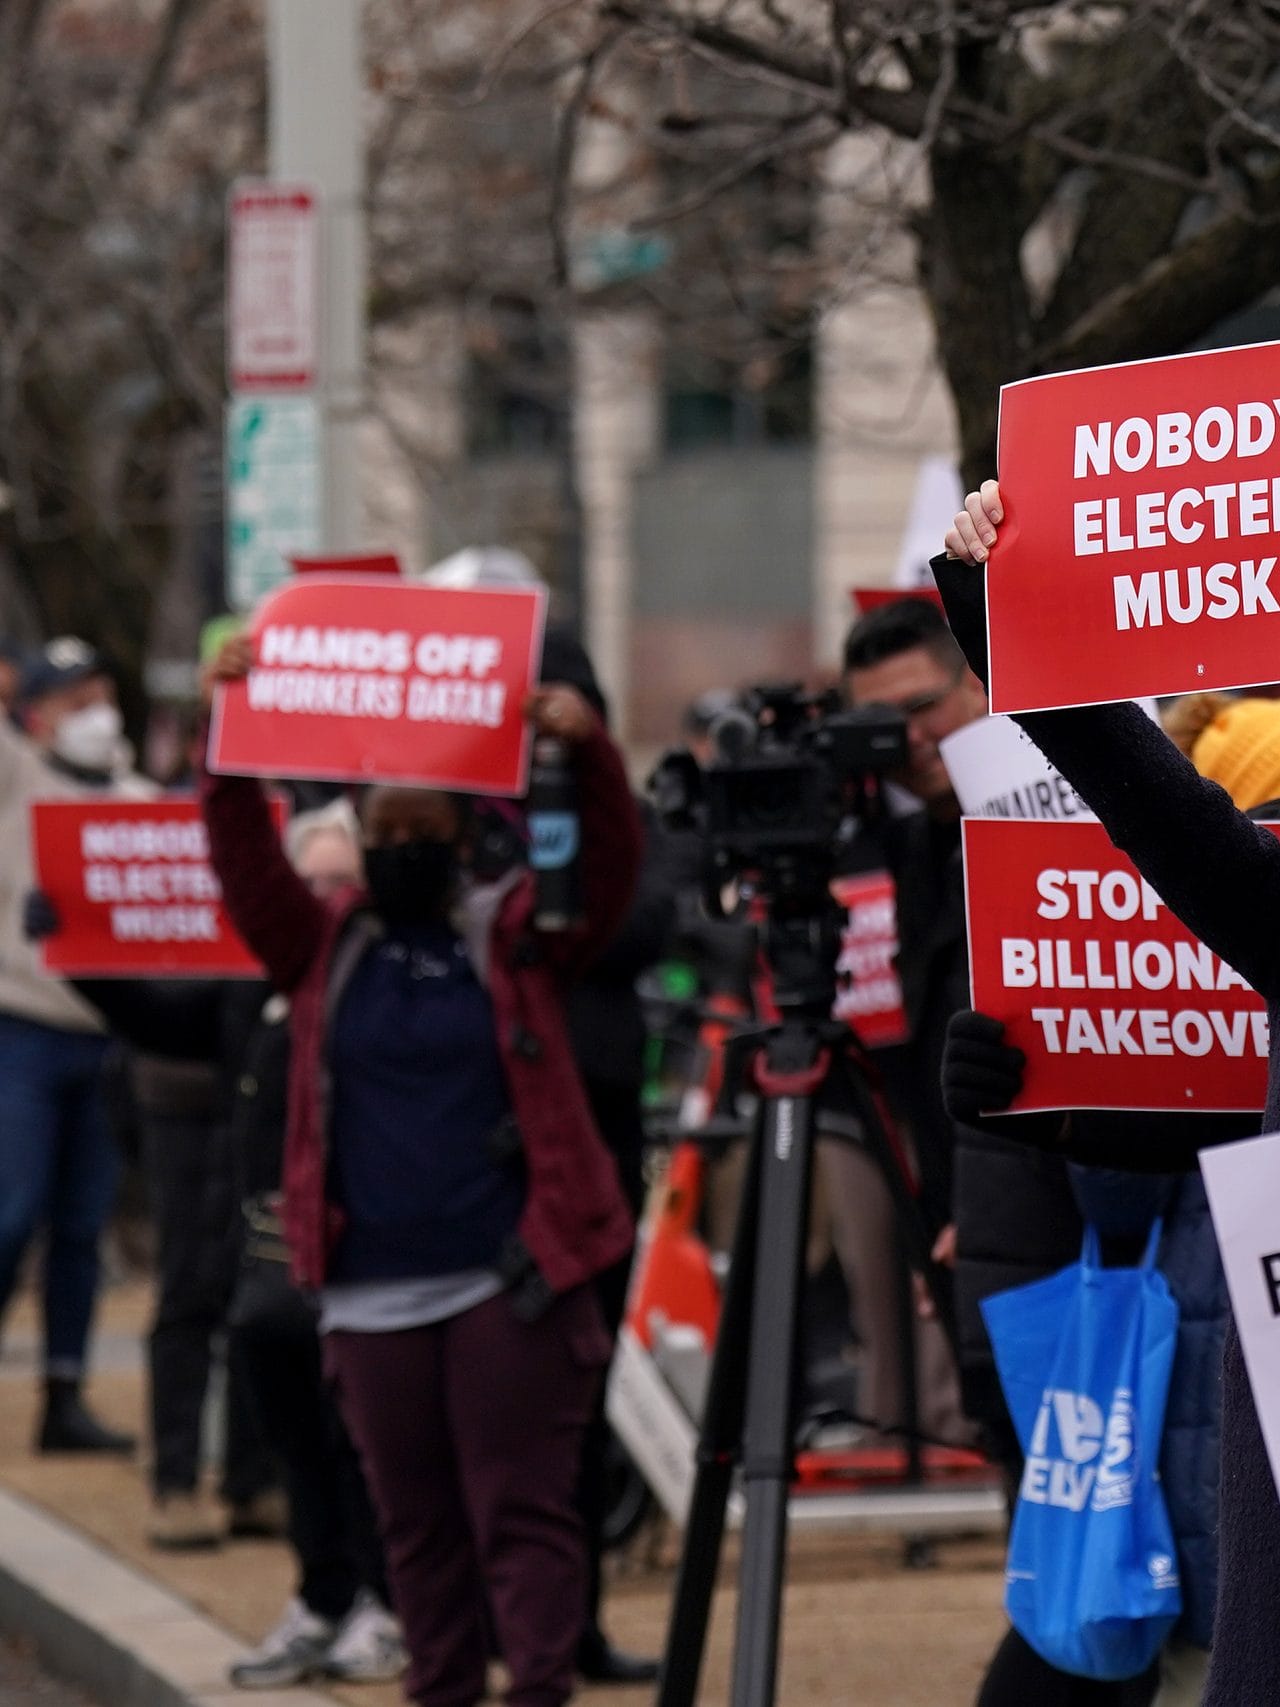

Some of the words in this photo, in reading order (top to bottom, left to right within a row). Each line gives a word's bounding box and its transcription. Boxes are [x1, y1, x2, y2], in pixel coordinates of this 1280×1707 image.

[1114, 557, 1280, 630] MUSK
[261, 625, 411, 673] HANDS
[414, 633, 501, 677] OFF
[248, 670, 404, 719] WORKERS
[81, 820, 209, 861] NOBOD
[85, 863, 221, 902] ELECTE
[1002, 939, 1254, 992] BILLIONA
[1032, 1009, 1269, 1057] TAKEOVE
